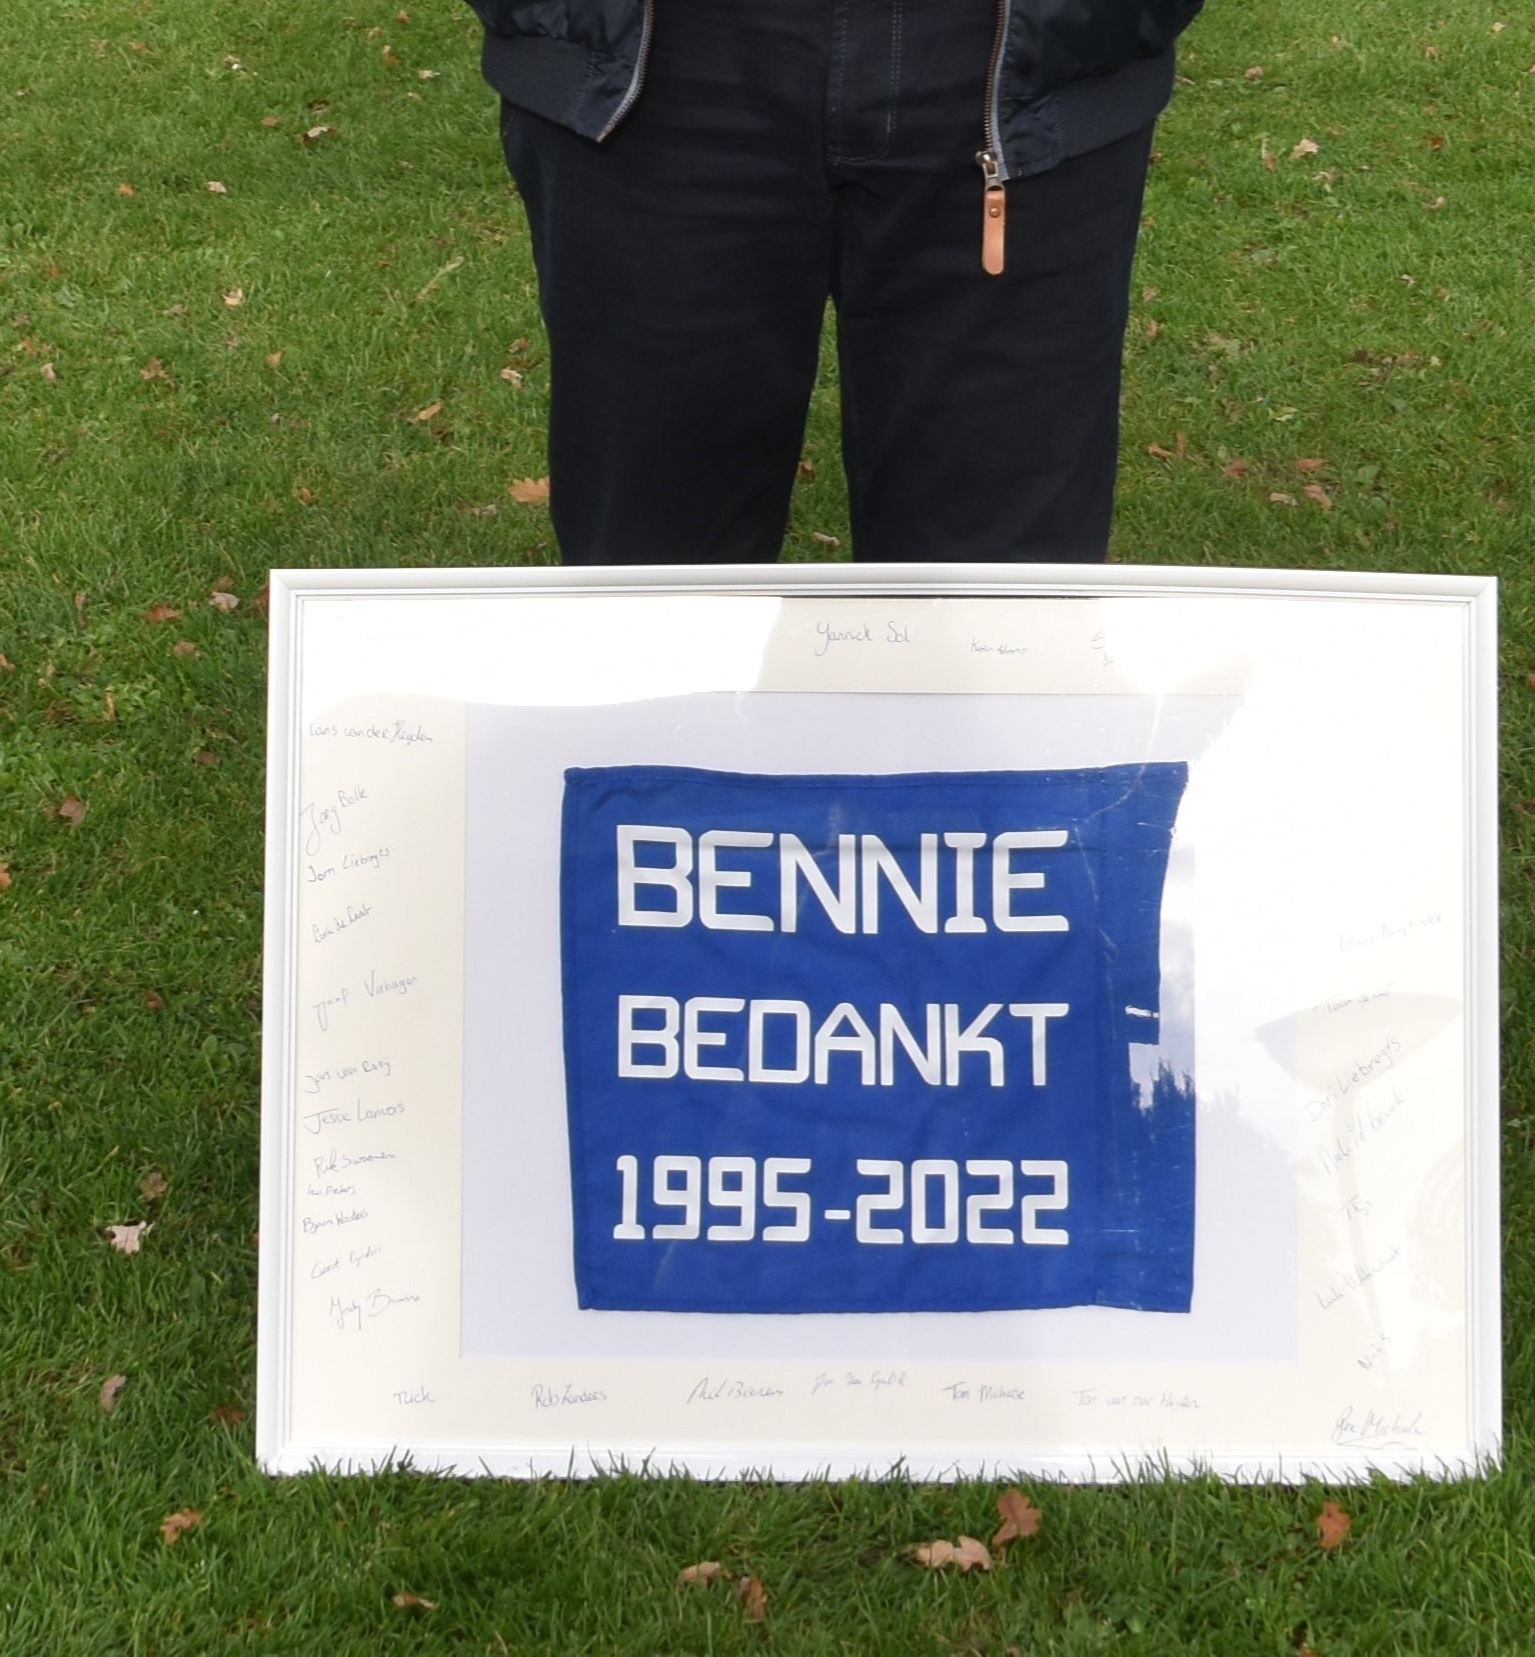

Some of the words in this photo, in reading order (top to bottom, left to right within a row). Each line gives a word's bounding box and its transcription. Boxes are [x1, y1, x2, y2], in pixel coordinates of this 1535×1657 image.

[616, 824, 1070, 934] BENNIE
[617, 994, 1070, 1087] BEDANKT
[613, 1154, 1069, 1246] 1995-2022
